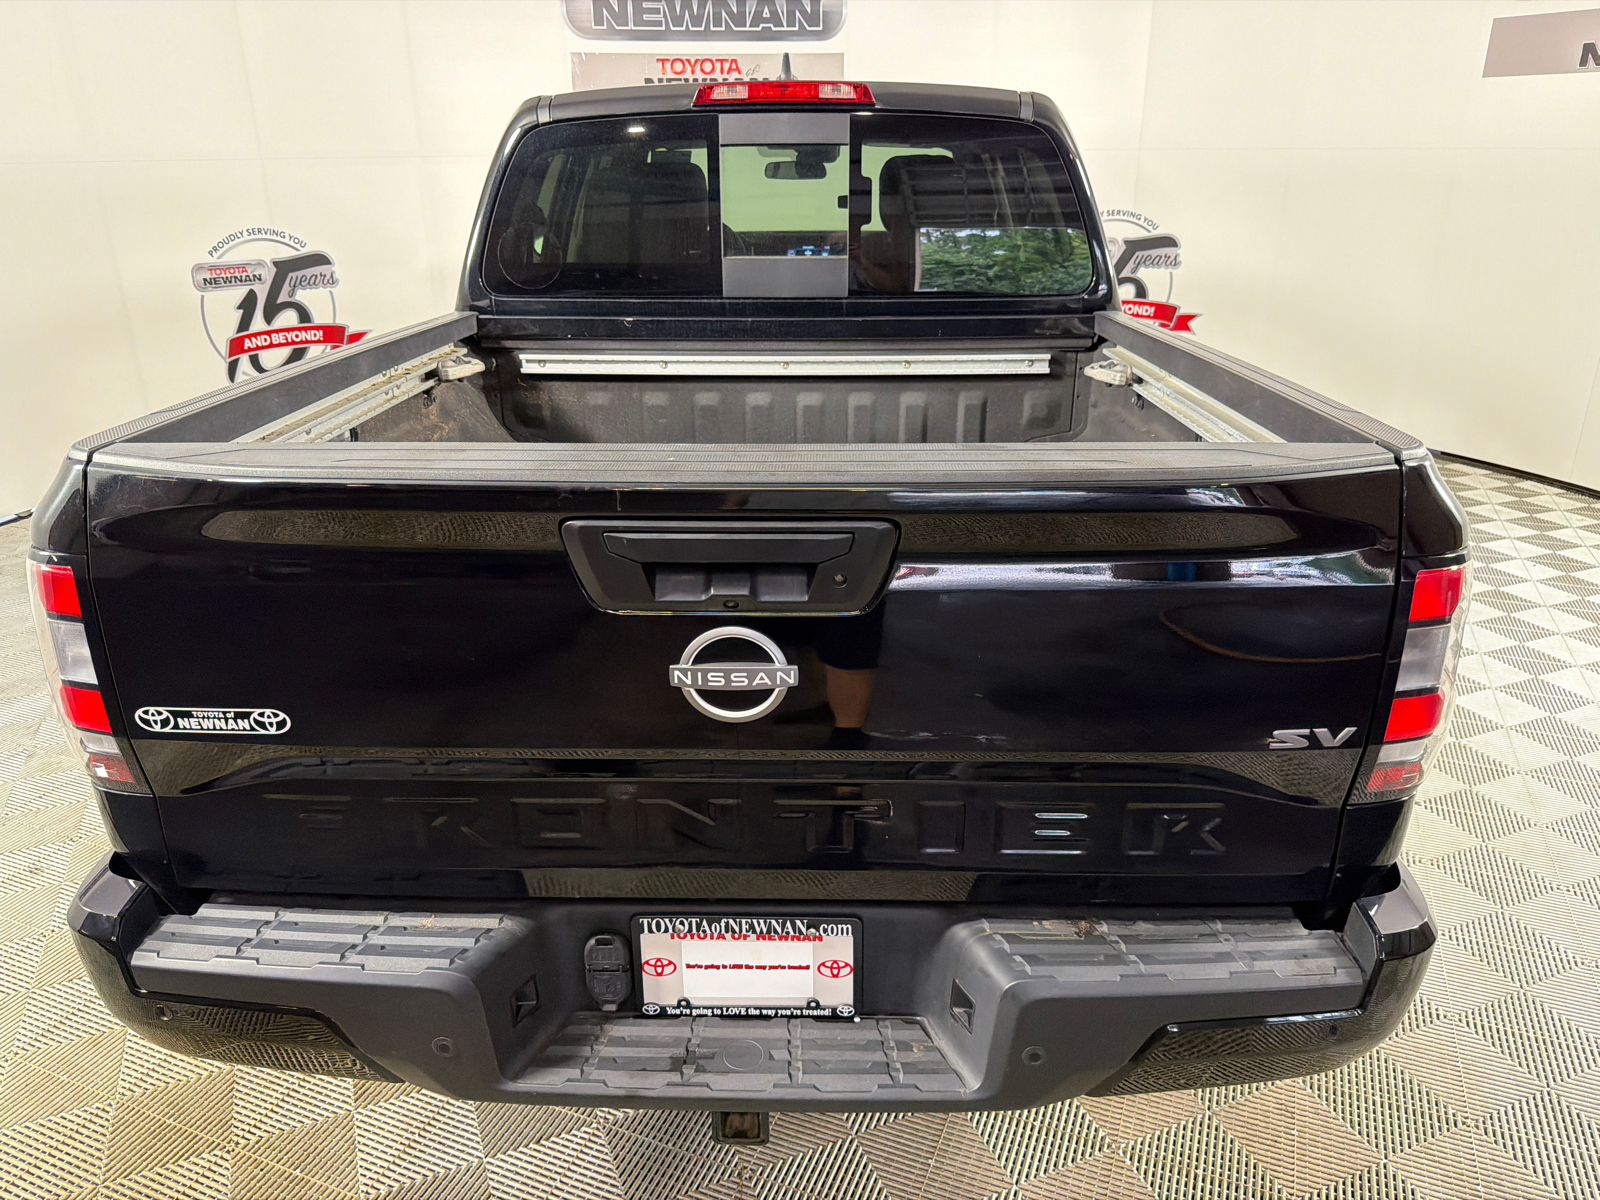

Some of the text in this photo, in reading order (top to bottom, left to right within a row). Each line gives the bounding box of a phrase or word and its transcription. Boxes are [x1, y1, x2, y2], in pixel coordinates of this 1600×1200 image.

[592, 0, 823, 30] NEWNAN
[656, 57, 761, 77] TOYOTA of
[1106, 209, 1141, 221] SERVING
[1142, 216, 1160, 231] YOU
[207, 227, 307, 258] PROUDLY SERVING YOU
[207, 266, 248, 276] TOYOTA
[1130, 252, 1181, 275] years
[202, 274, 263, 286] NEWNAN
[288, 272, 338, 299] years
[243, 329, 324, 350] AND BEYOND!
[673, 670, 794, 686] NISSAN
[177, 717, 251, 730] NEWNAN
[1268, 726, 1358, 750] SV
[666, 1006, 832, 1018] You're going to LOVE the way you're treated!
